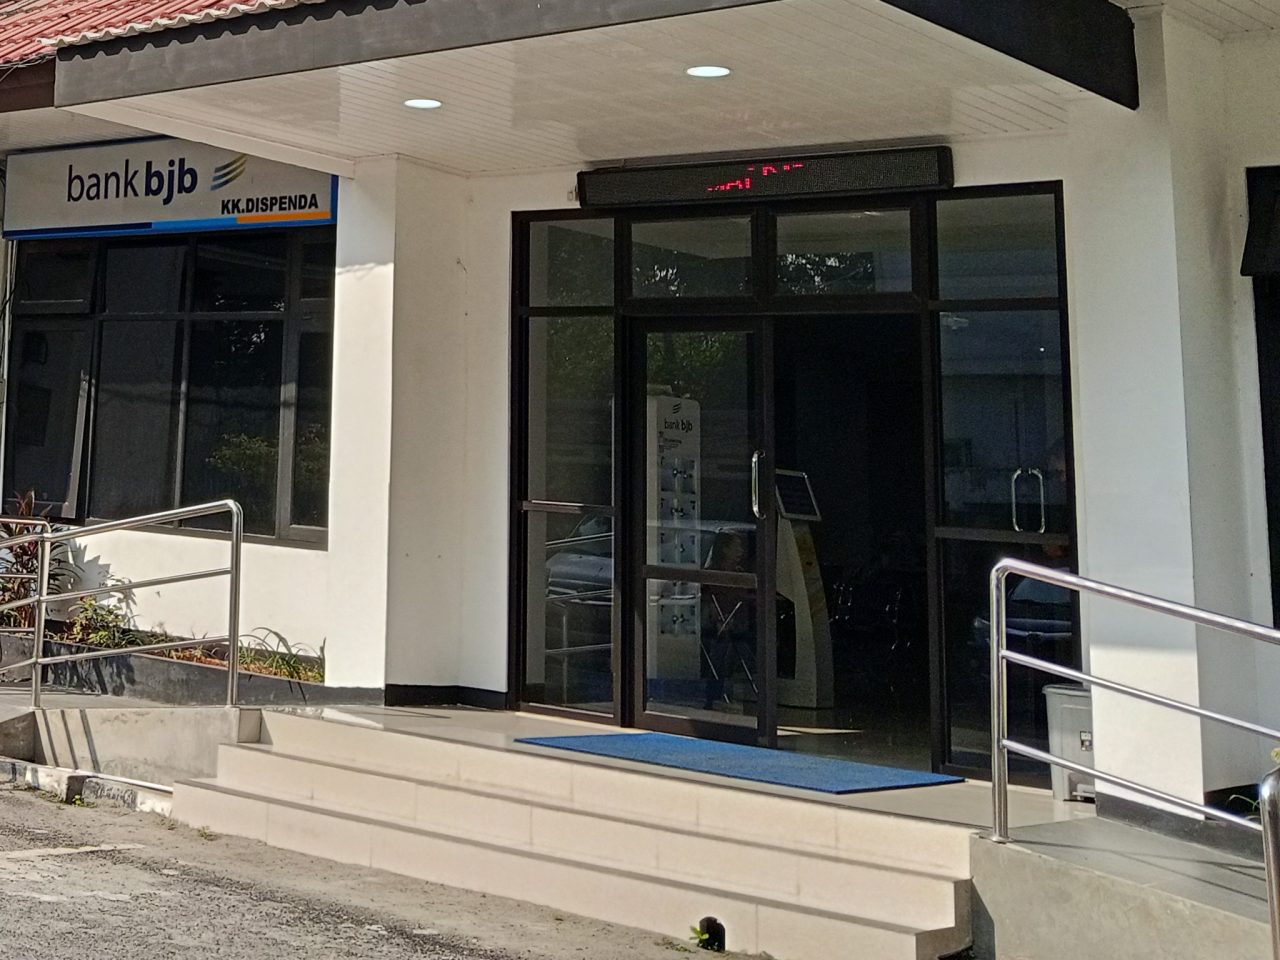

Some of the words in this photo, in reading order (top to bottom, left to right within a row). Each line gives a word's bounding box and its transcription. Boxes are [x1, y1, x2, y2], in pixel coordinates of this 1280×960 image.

[67, 158, 139, 202] bank
[144, 158, 198, 205] bjb
[221, 193, 318, 215] KK.DISPENDA
